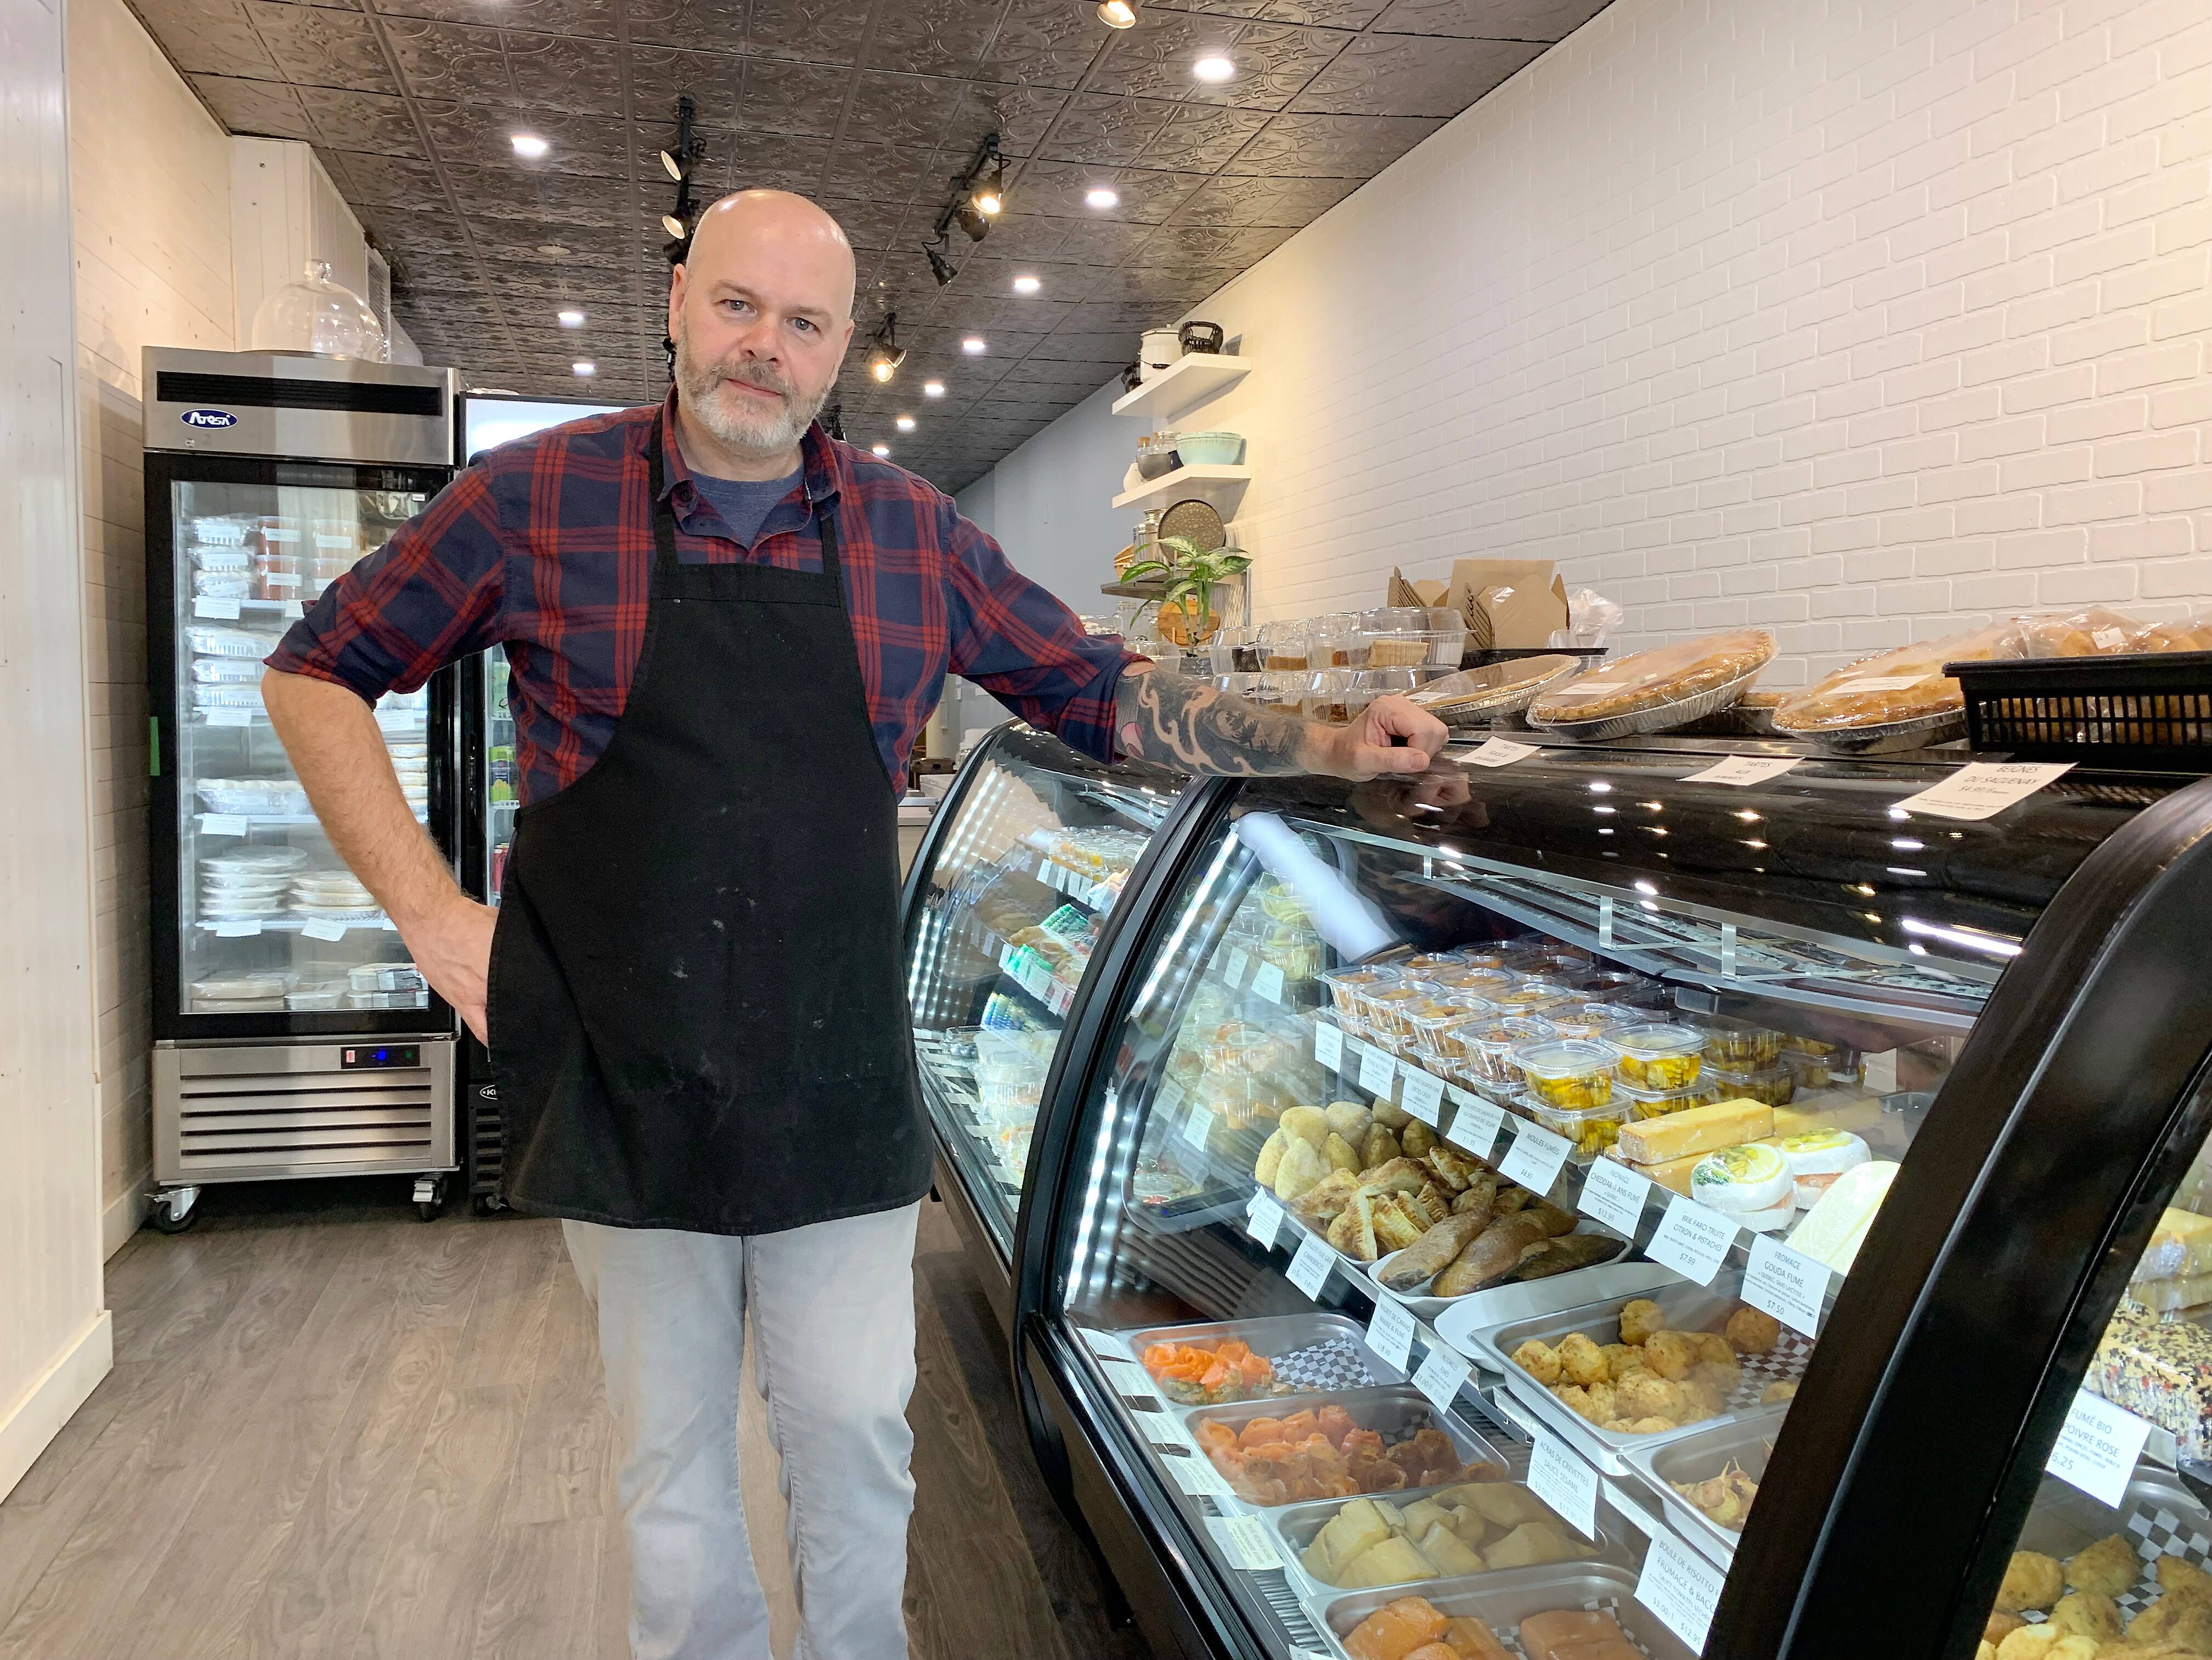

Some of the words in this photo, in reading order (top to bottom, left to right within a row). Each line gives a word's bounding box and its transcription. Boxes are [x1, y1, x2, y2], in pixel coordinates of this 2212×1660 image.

[1980, 776, 2039, 785] SAGUENAY
[1526, 1133, 1545, 1147] MOULES
[1544, 1143, 1561, 1155] FUMÉES
[1590, 1172, 1613, 1189] CHEDDAR
[1617, 1186, 1627, 1197] ANS
[1627, 1191, 1641, 1204] FUMÉ
[1598, 1207, 1615, 1222] $12.99
[1673, 1224, 1692, 1238] CITRON
[1697, 1235, 1723, 1252] PISTACHES
[1681, 1214, 1692, 1225] BRIE
[1693, 1219, 1708, 1231] FARCI
[1708, 1226, 1726, 1240] TRUITE
[1679, 1252, 1696, 1265] $7.99
[1774, 1251, 1802, 1270] FROMAGE
[1764, 1261, 1786, 1278] GOUDA
[1786, 1272, 1804, 1288] FUMÉ
[1391, 1312, 1397, 1321] DE
[1767, 1299, 1785, 1315] $7.50
[1394, 1328, 1406, 1340] FUMÉ
[1415, 1373, 1433, 1391] $3.00/1
[2071, 1408, 2096, 1427] FUMÉ
[2096, 1420, 2112, 1434] BIO
[2064, 1422, 2096, 1445] POIVRE
[2096, 1439, 2120, 1458] ROSE
[1539, 1441, 1555, 1458] ACRAS
[1555, 1453, 1562, 1465] DE
[1562, 1460, 1589, 1487] CREVETTES
[1544, 1459, 1559, 1477] SAUCE
[2051, 1451, 2074, 1470] 6.25
[1659, 1540, 1678, 1561] BOULE
[1677, 1557, 1686, 1569] DE
[1686, 1565, 1714, 1594] RISOTTO
[1657, 1557, 1688, 1590] FROMAGE
[1689, 1586, 1695, 1596] &
[1696, 1592, 1716, 1614] BACO
[1653, 1597, 1674, 1620] $3.00/1
